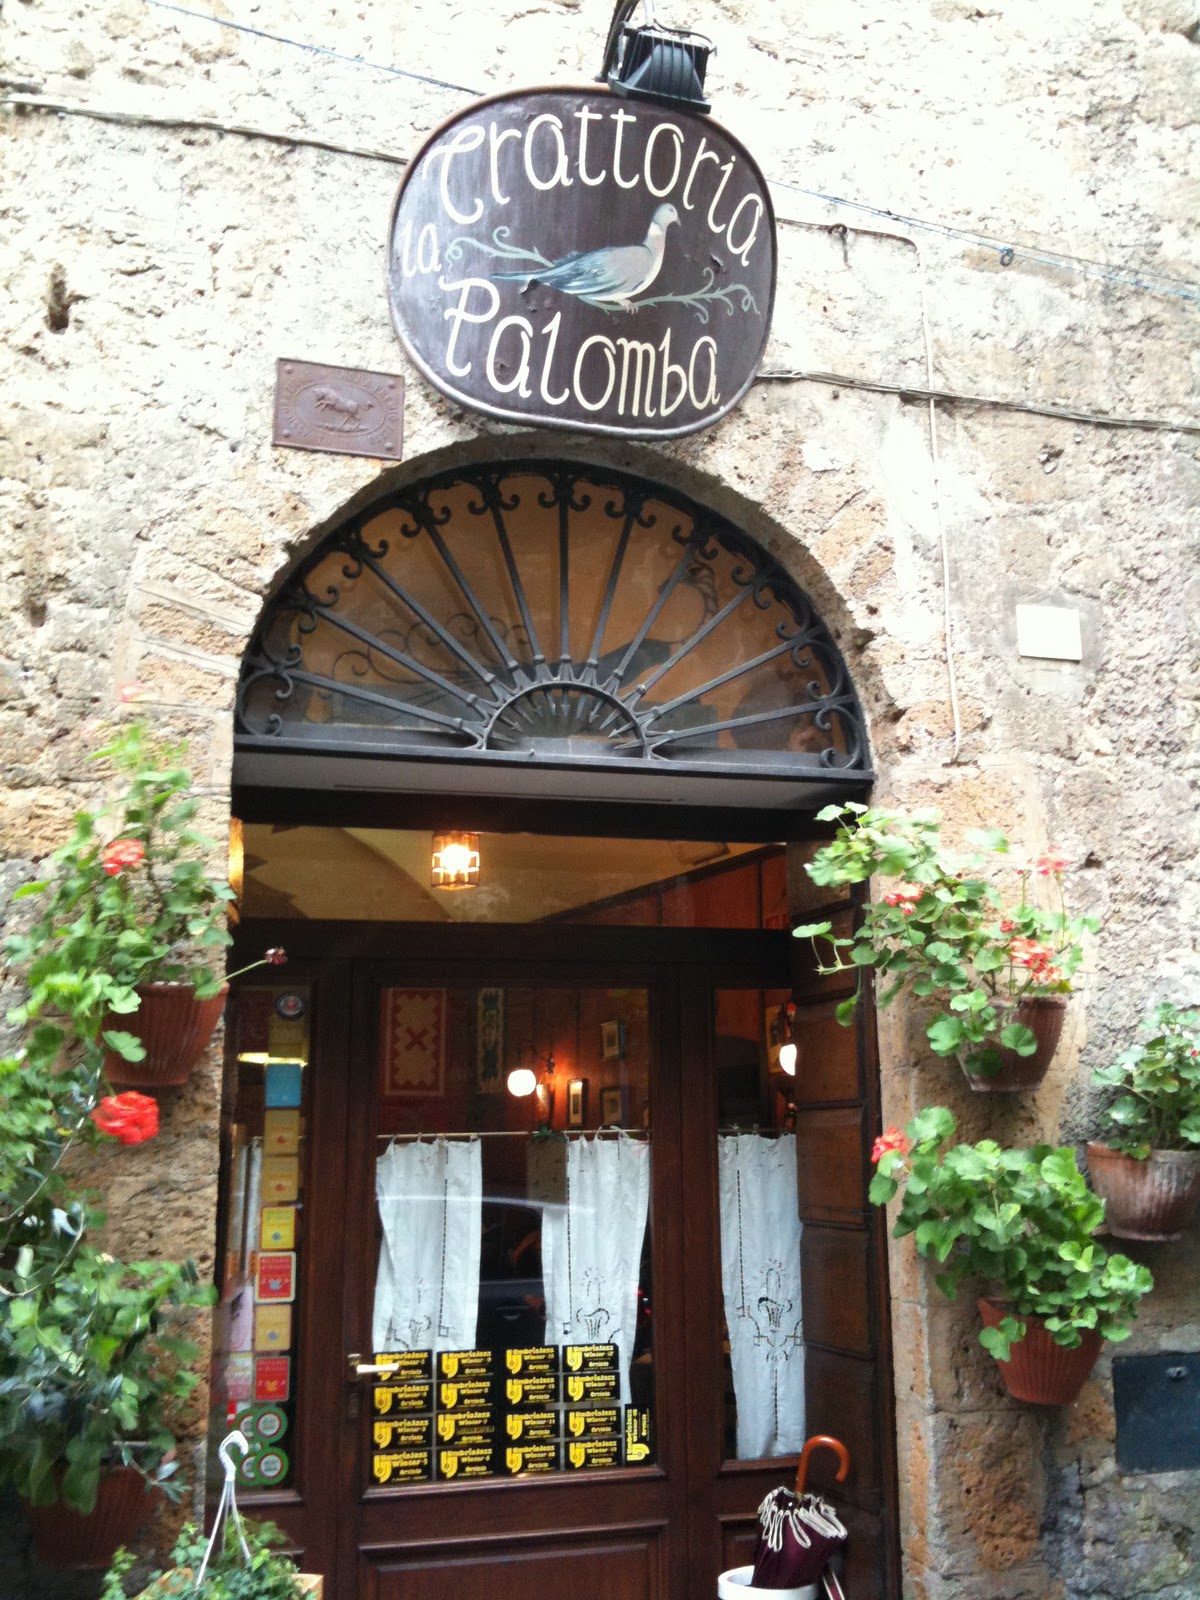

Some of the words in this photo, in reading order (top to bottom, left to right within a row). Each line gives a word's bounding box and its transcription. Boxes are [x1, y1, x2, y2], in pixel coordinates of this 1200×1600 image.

[400, 220, 442, 278] la
[422, 105, 762, 266] Trattoria
[439, 276, 720, 417] Palomba
